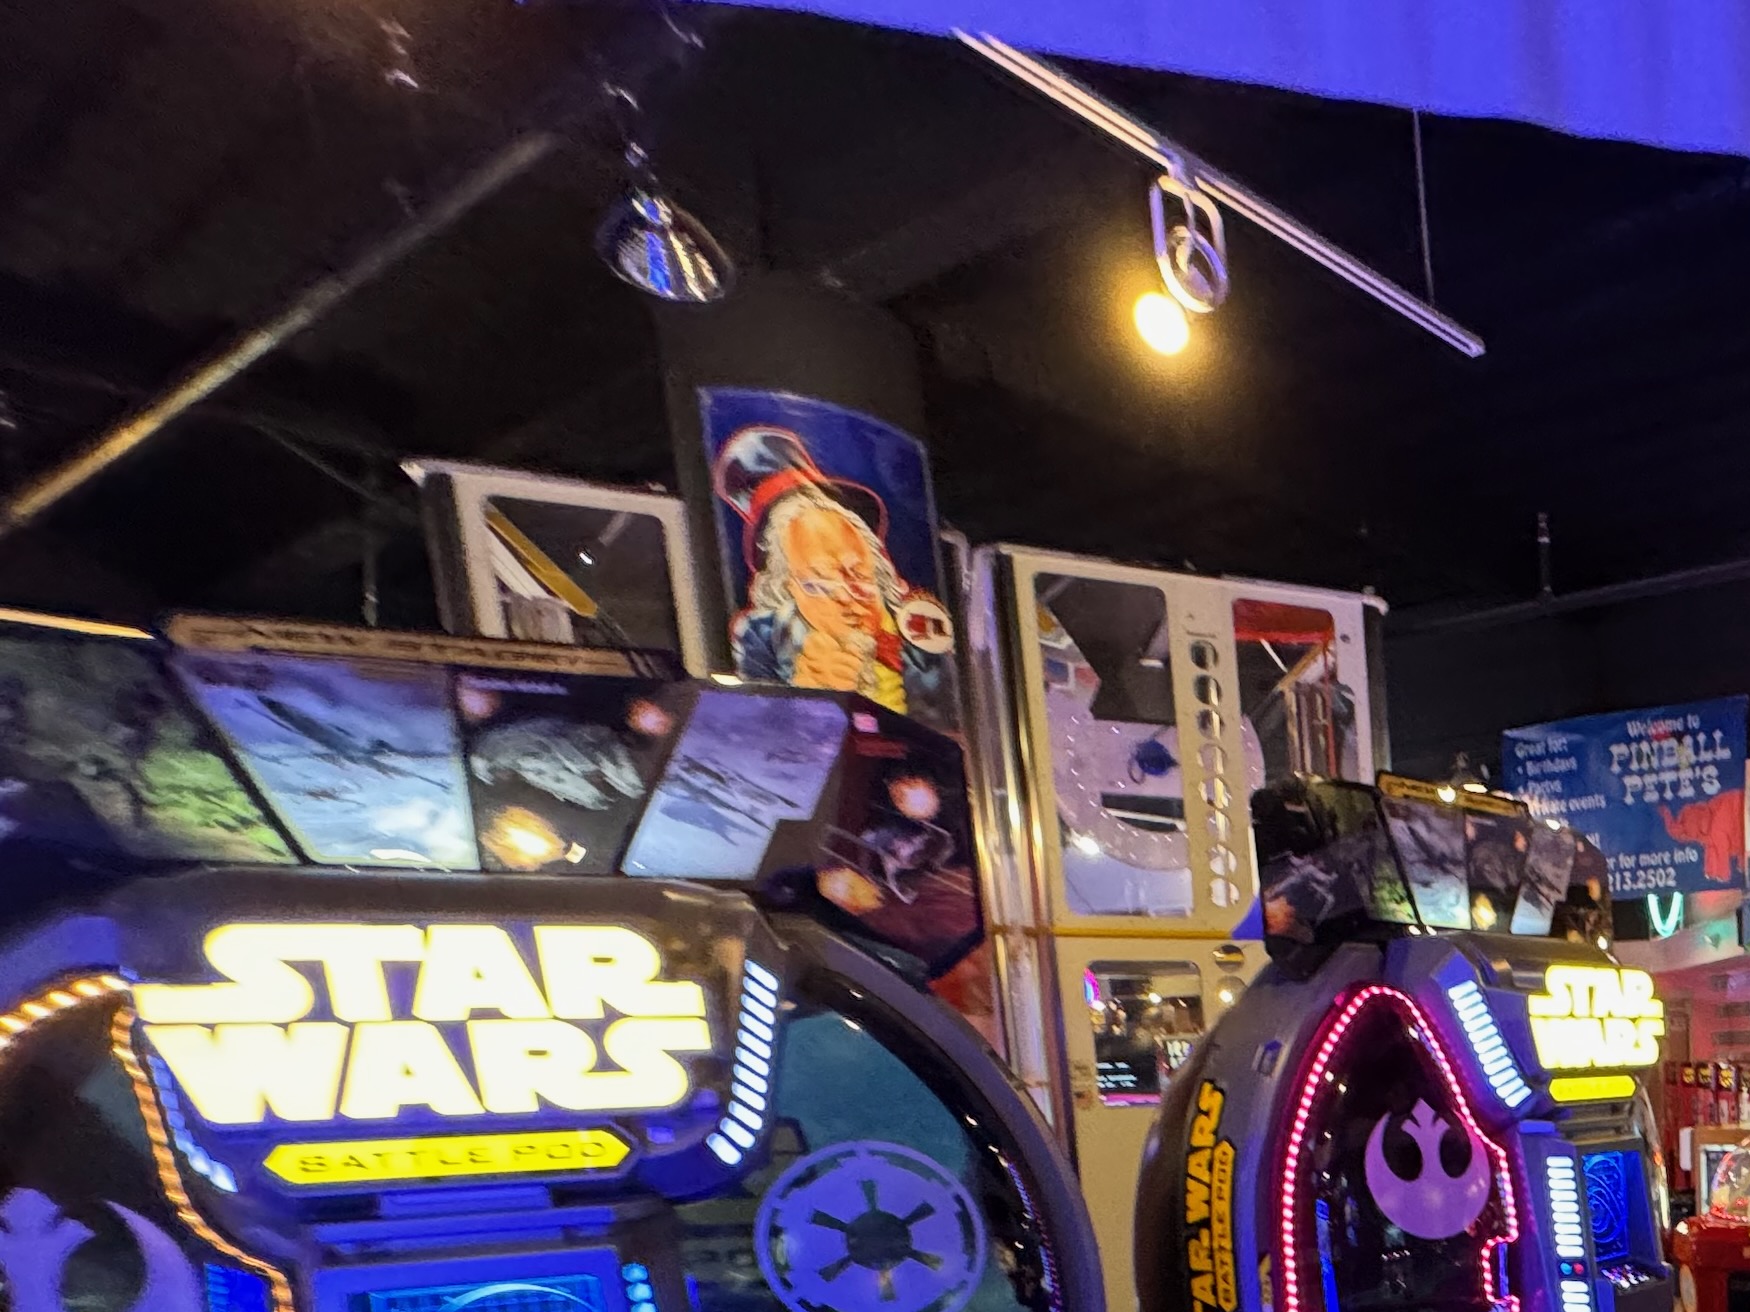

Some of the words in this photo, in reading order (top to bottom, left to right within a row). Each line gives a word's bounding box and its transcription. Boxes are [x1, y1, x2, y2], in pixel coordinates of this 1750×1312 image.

[1609, 728, 1732, 775] PINBALL
[1622, 764, 1721, 805] PETE'S
[1618, 851, 1638, 869] for
[1639, 850, 1672, 868] more
[1673, 846, 1699, 865] info
[134, 924, 705, 1024] STAR
[1528, 965, 1664, 1018] STAR
[1529, 1015, 1665, 1070] WARS
[143, 1017, 711, 1124] WARS
[298, 1147, 494, 1174] BATTLE
[512, 1141, 608, 1163] POD
[1185, 1080, 1225, 1225] WARS
[1215, 1150, 1230, 1196] POD
[1216, 1210, 1232, 1303] BATTLE
